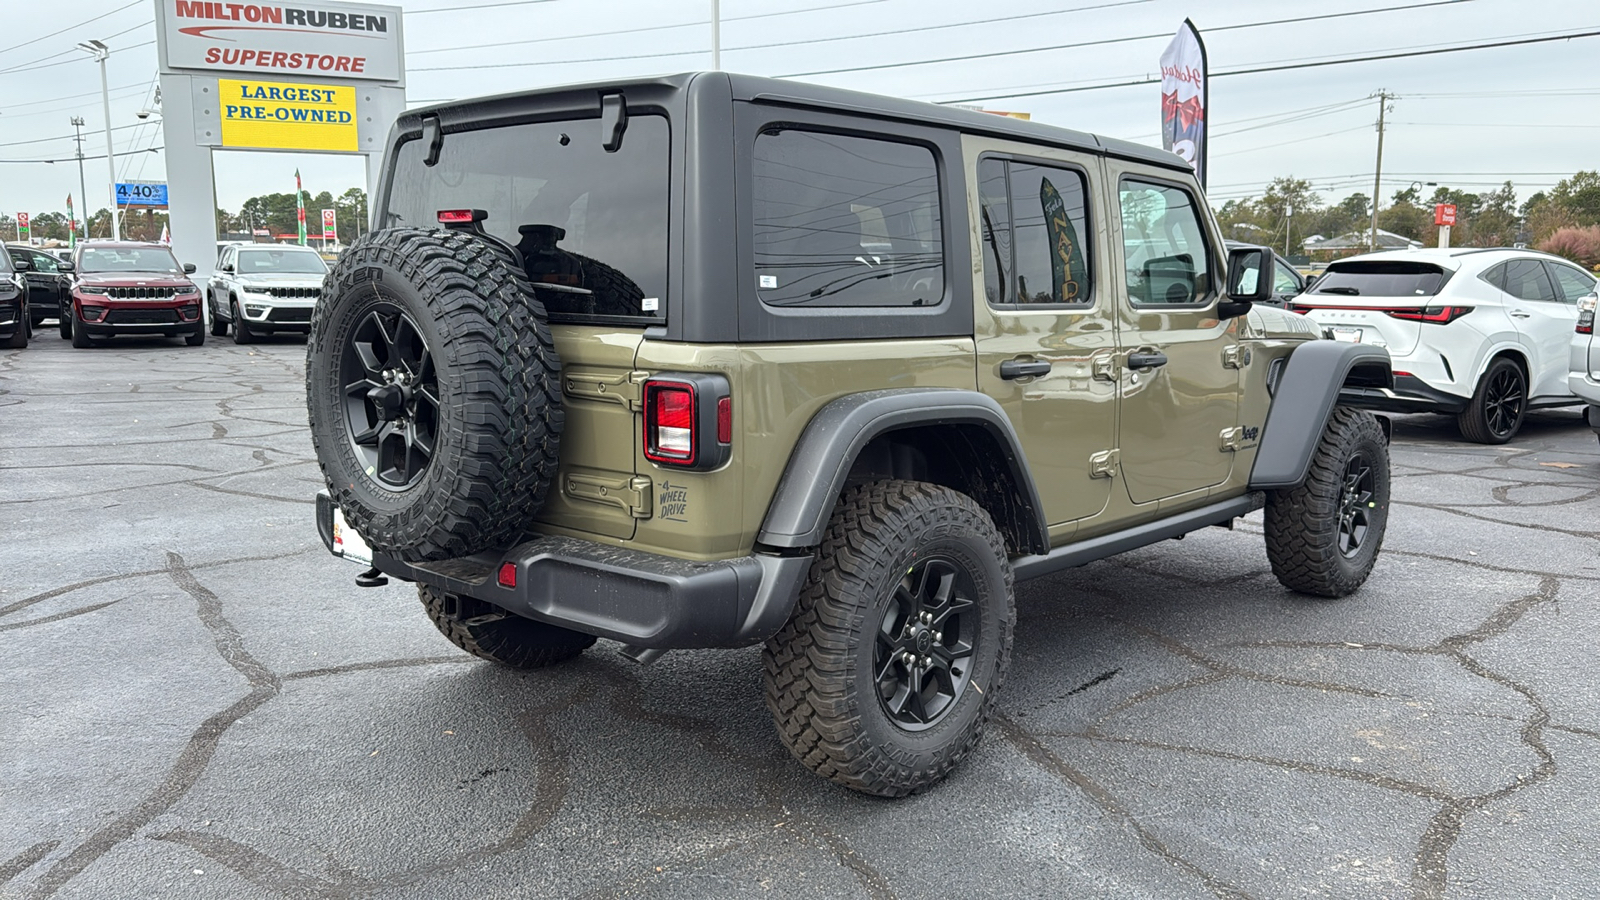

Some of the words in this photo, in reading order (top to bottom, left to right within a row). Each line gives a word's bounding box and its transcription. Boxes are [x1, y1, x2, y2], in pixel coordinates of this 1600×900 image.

[176, 0, 283, 24] MILTON
[285, 8, 388, 33] RUBEN
[205, 47, 366, 73] SUPERSTORE
[241, 85, 335, 103] LARGEST
[226, 105, 352, 124] PRE-OWNED
[1053, 212, 1079, 303] NAVID
[662, 480, 669, 491] 4
[660, 491, 687, 505] WHEEL
[661, 503, 687, 519] DRIVE
